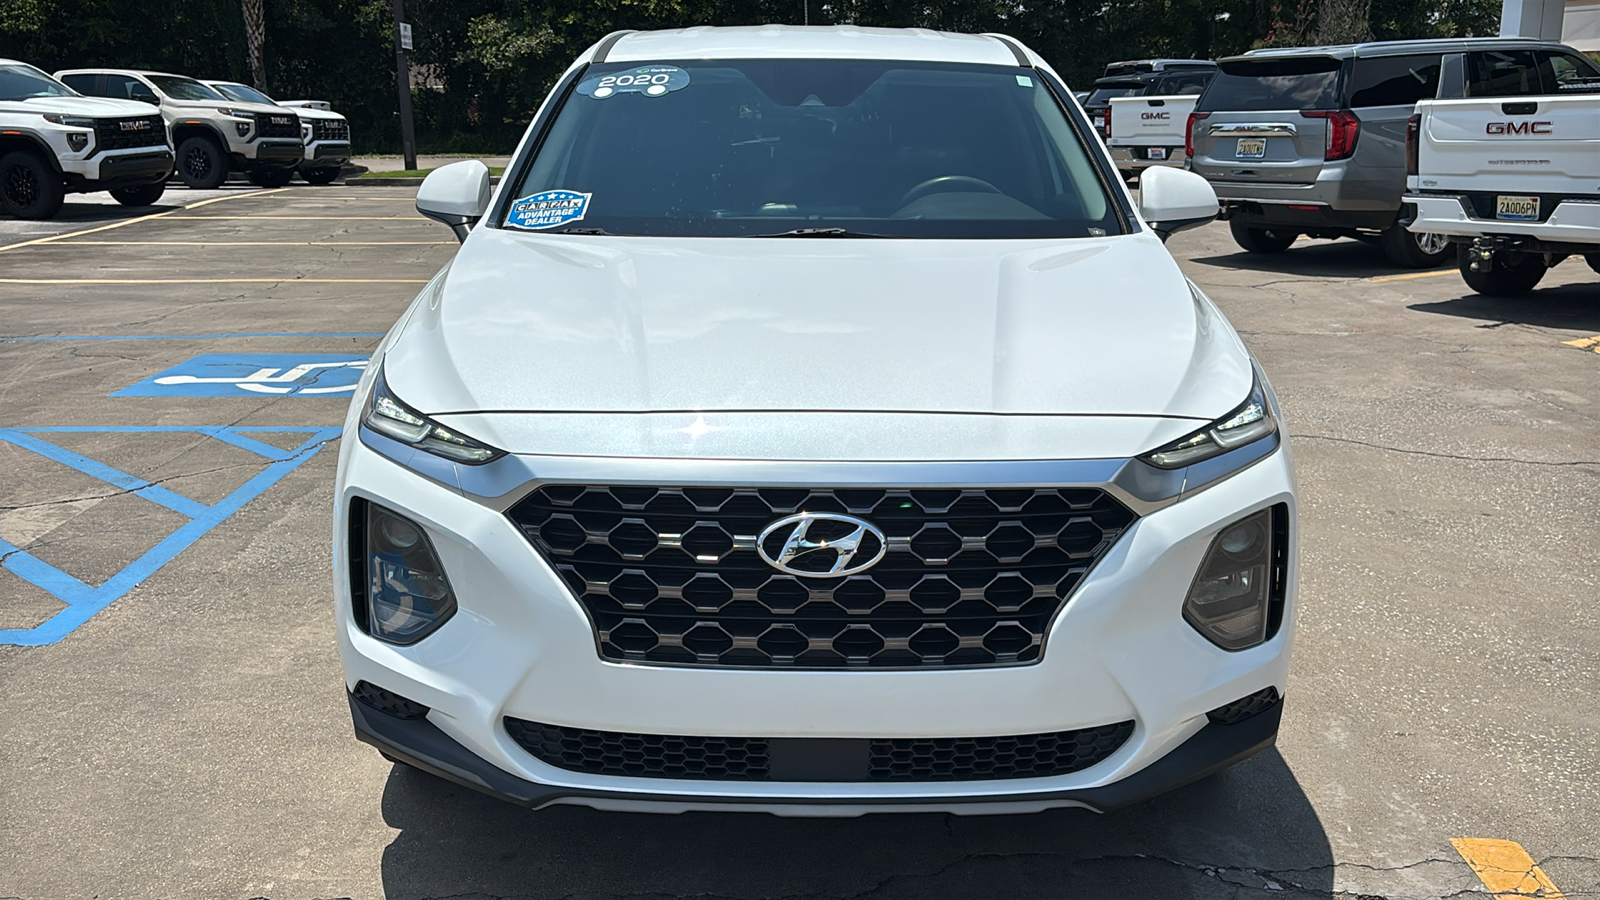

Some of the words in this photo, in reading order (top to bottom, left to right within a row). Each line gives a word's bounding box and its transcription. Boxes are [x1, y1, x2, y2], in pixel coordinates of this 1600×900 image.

[598, 74, 670, 87] 2020
[1141, 112, 1170, 120] GMC
[1486, 121, 1553, 135] GMC
[516, 200, 580, 212] CARFAX
[517, 208, 574, 220] ADVANTAGE
[524, 216, 562, 226] DEALER
